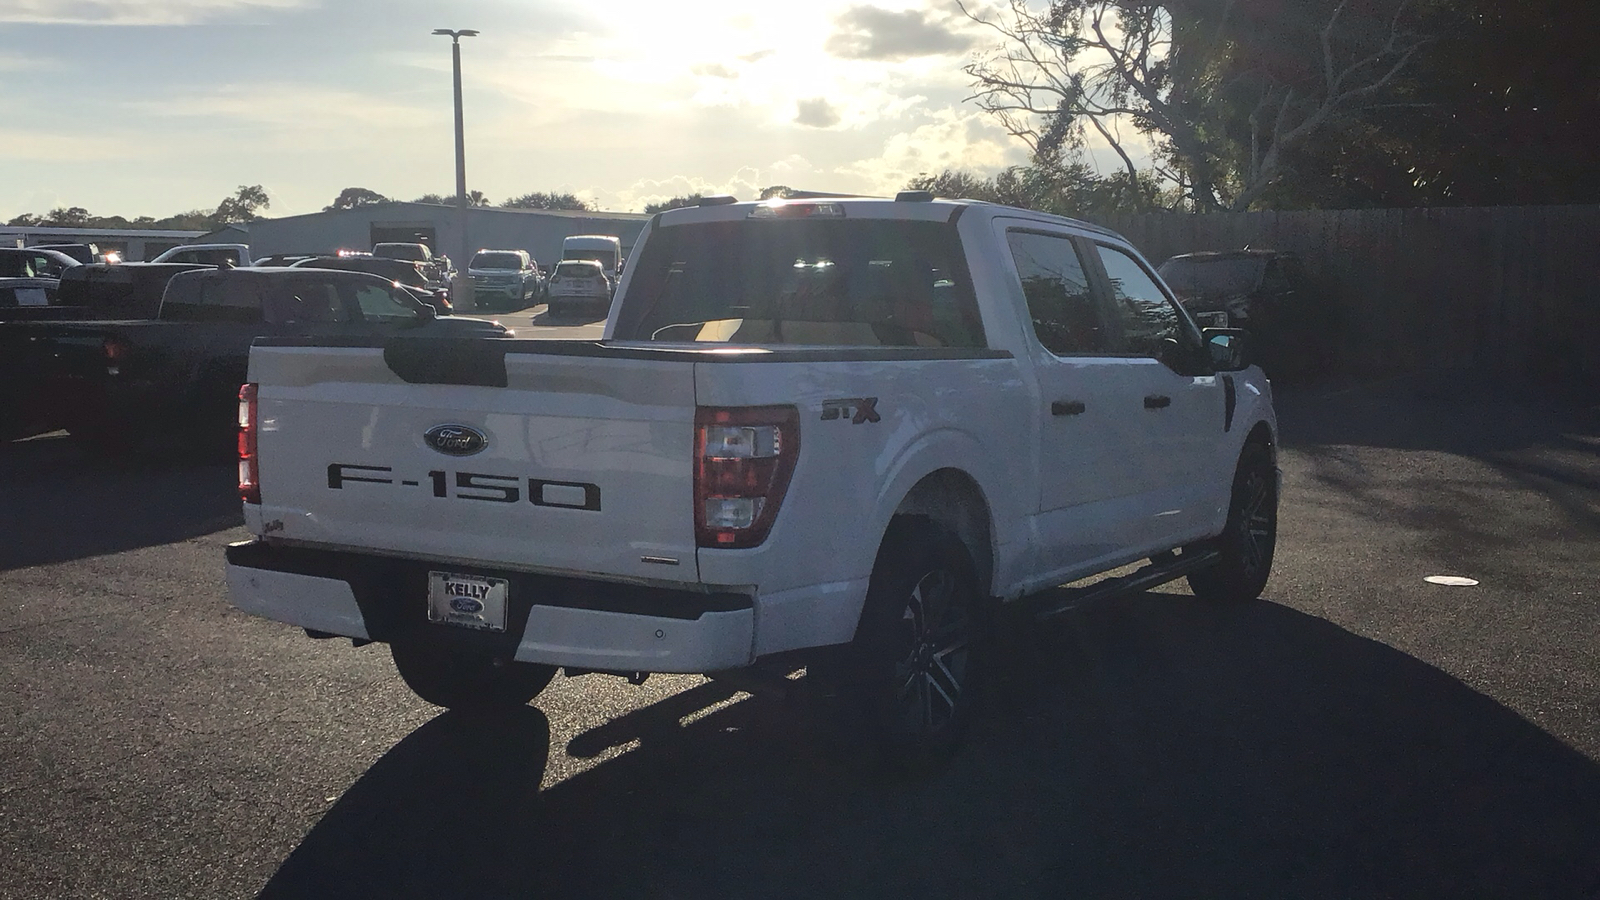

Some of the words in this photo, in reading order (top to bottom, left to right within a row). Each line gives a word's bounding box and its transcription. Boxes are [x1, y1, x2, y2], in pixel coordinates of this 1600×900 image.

[820, 397, 881, 424] STX
[436, 429, 471, 449] Ford
[327, 463, 602, 511] F-150
[444, 581, 492, 600] KELLY
